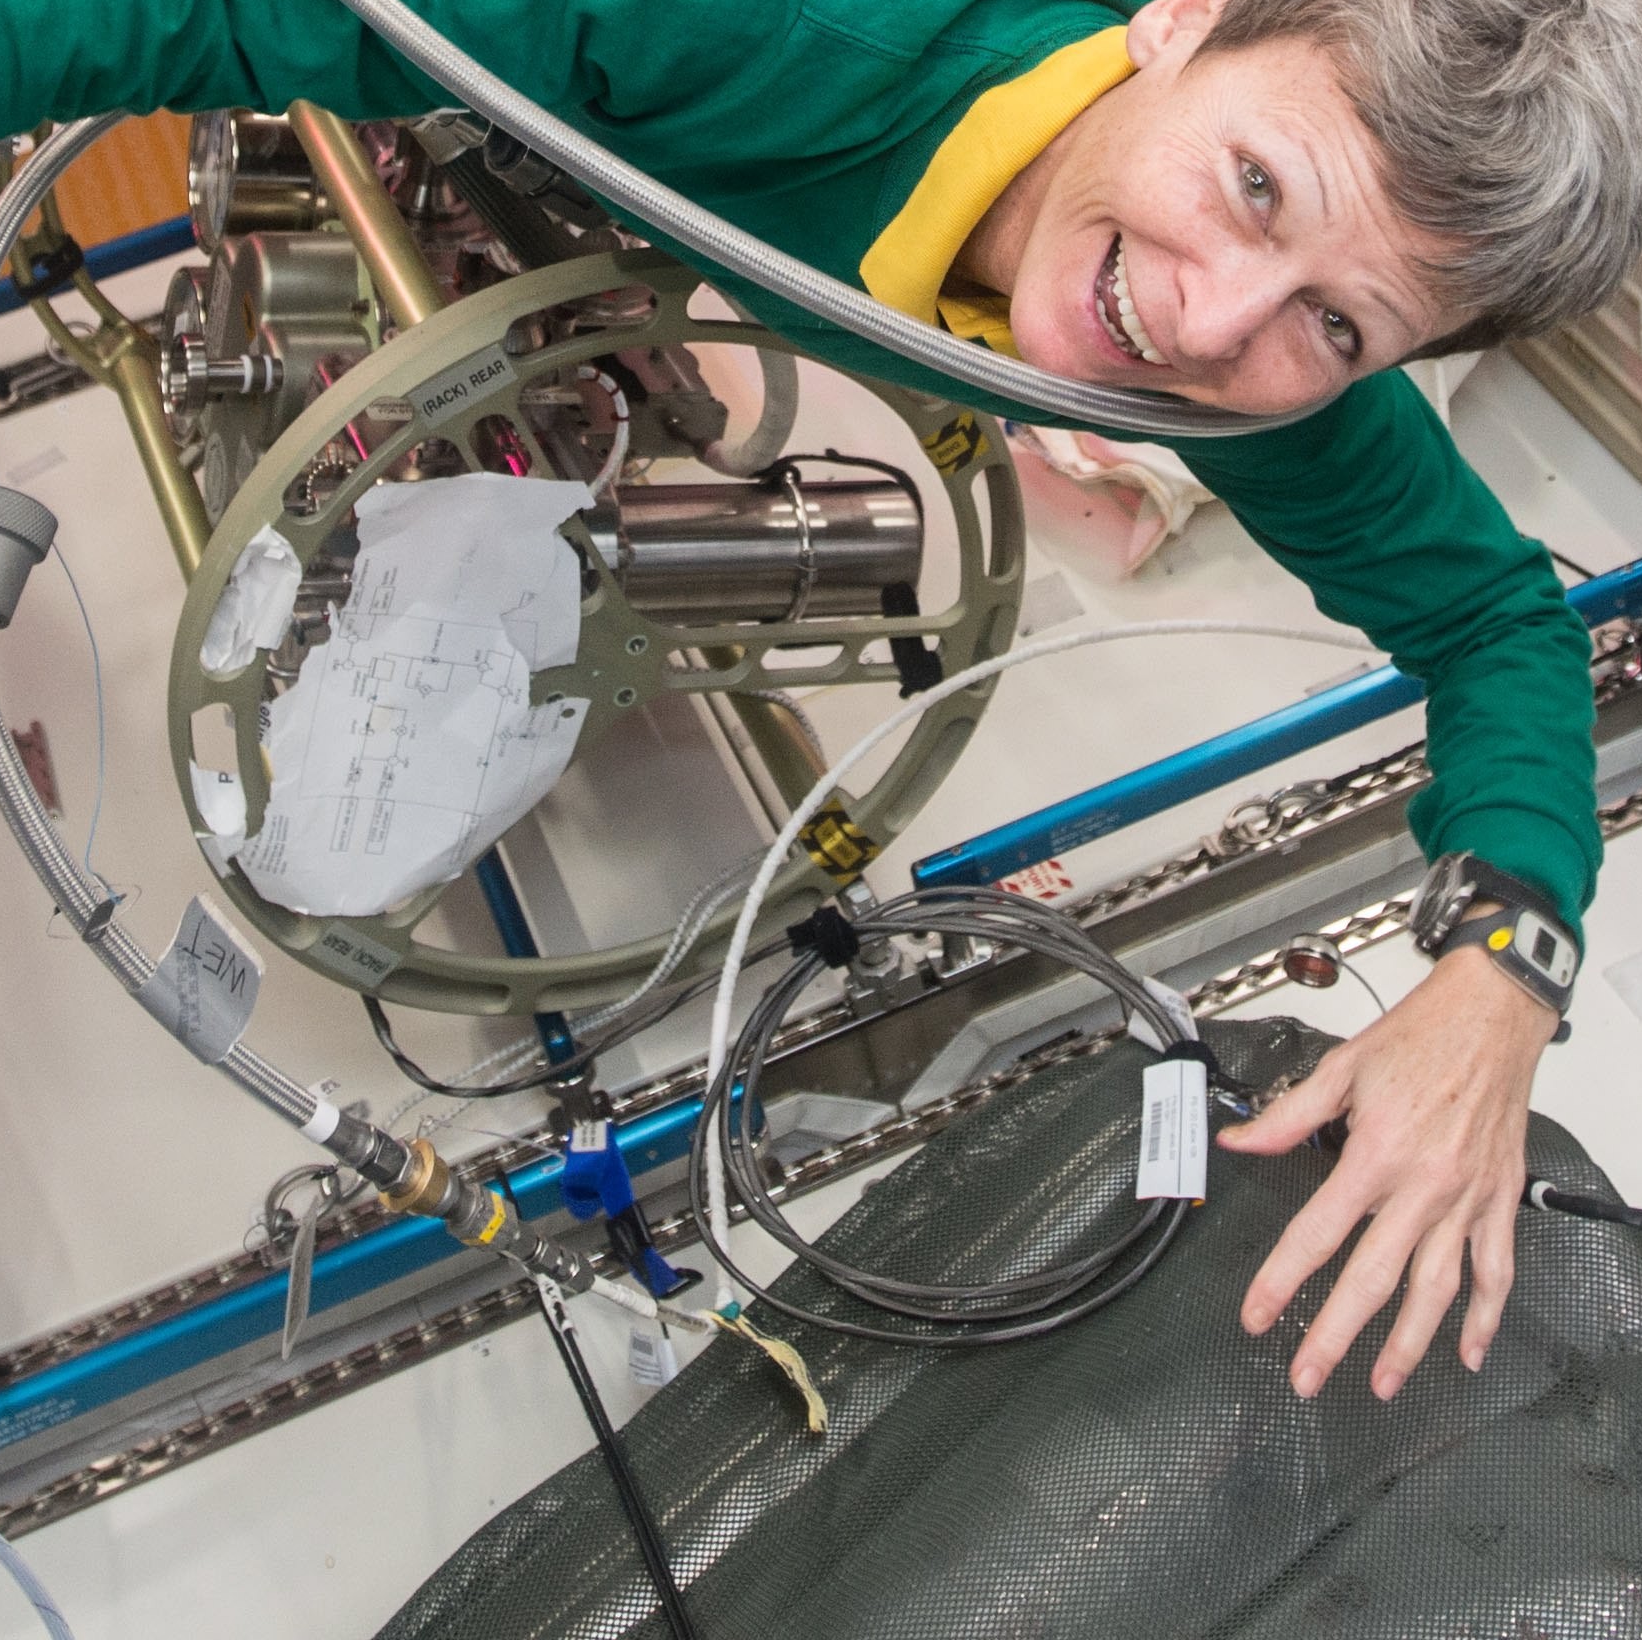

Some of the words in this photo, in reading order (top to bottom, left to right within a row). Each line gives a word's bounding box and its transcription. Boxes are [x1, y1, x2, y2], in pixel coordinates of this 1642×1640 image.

[422, 383, 468, 418] (RACK)
[469, 360, 506, 388] REAR
[182, 915, 246, 998] WET
